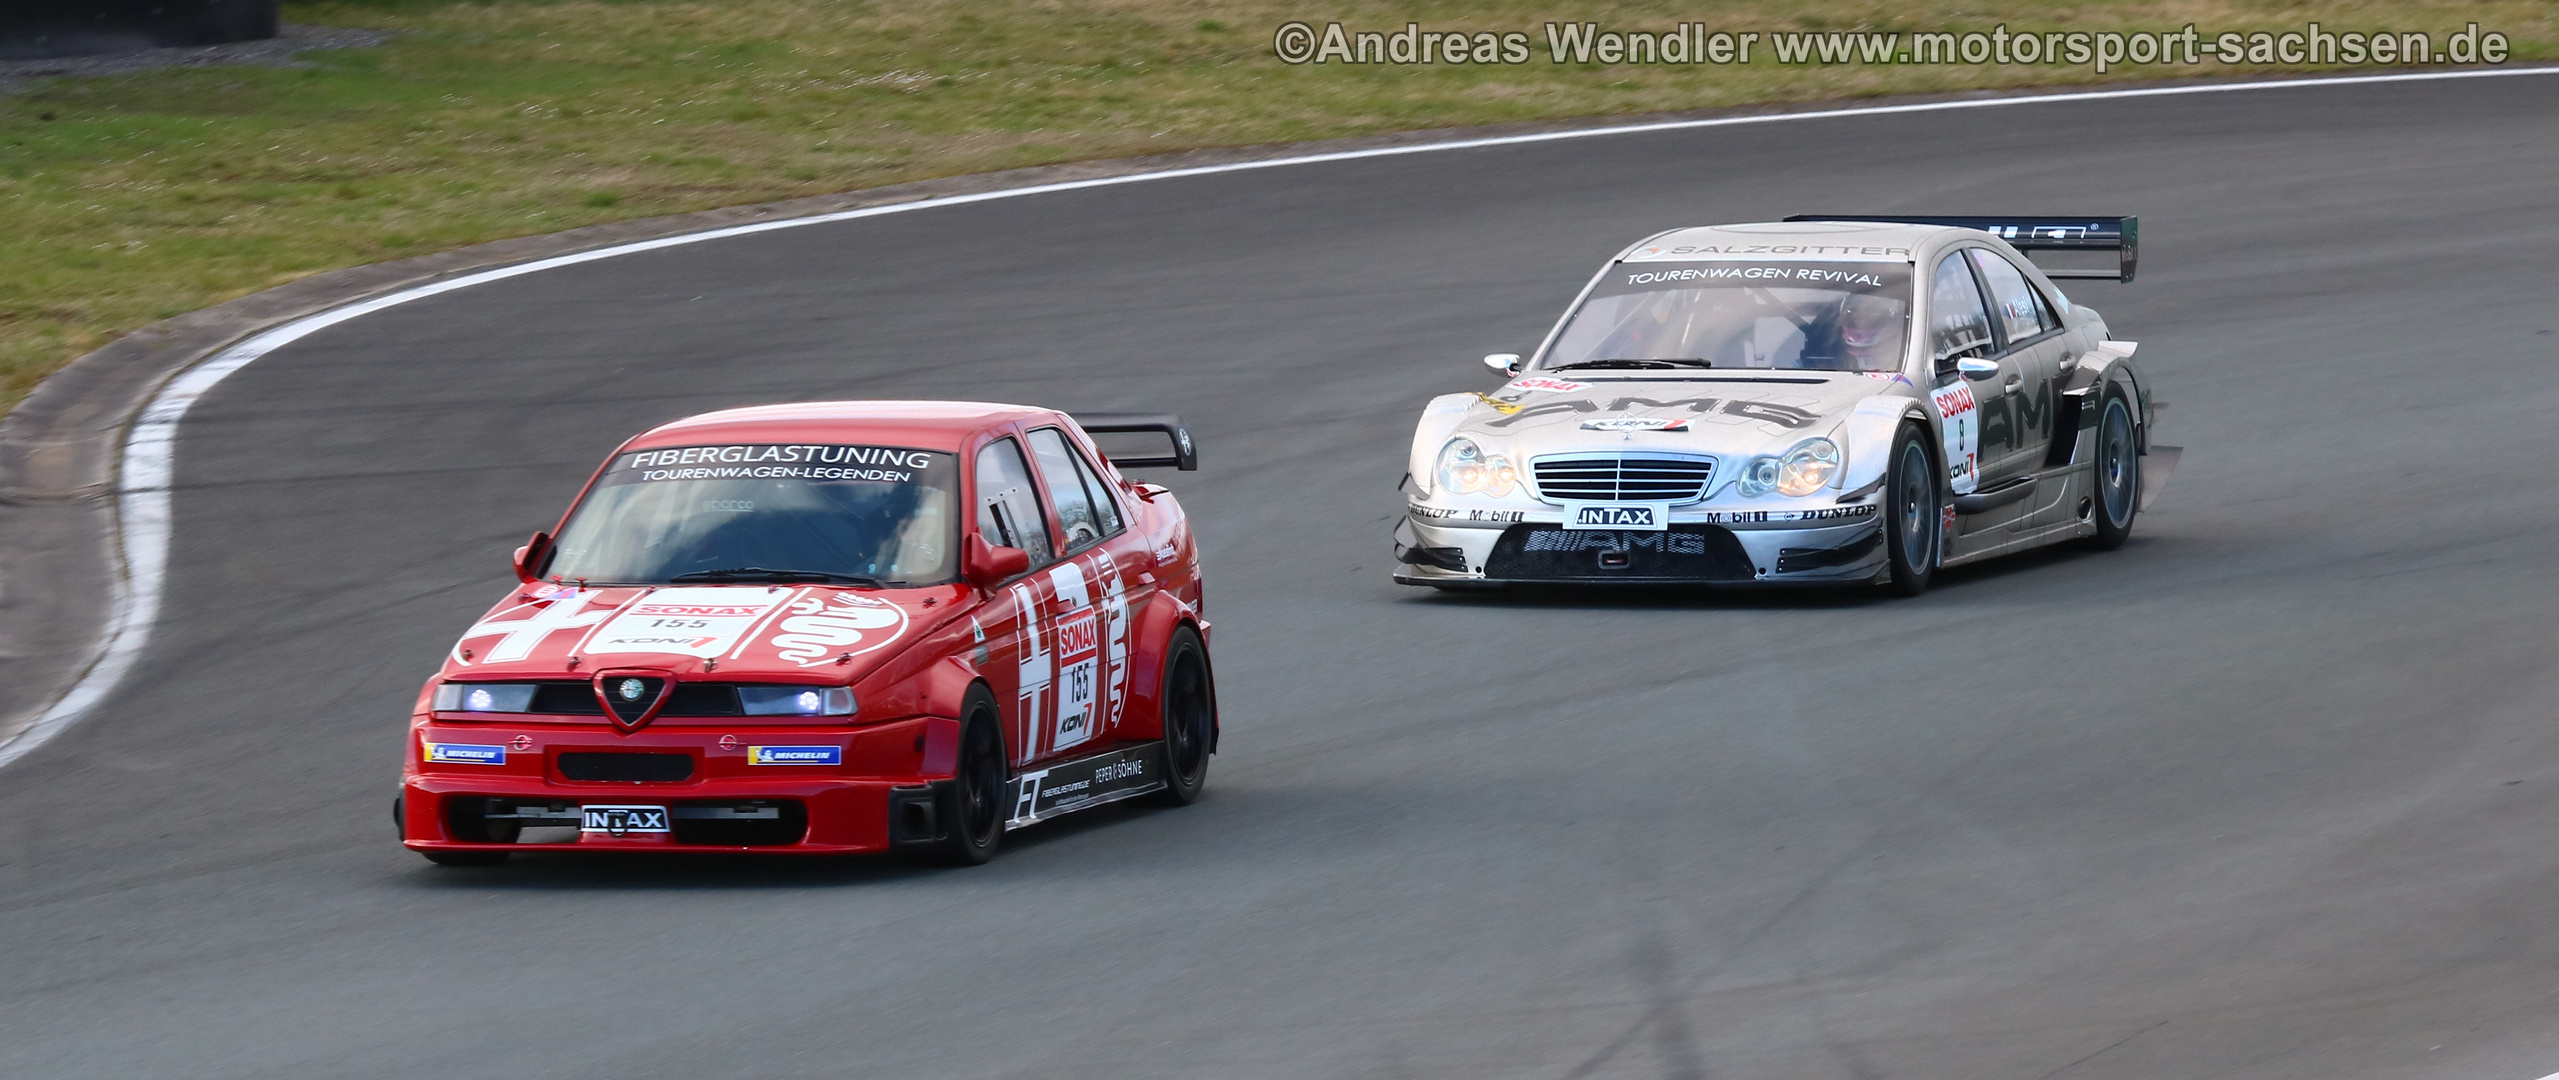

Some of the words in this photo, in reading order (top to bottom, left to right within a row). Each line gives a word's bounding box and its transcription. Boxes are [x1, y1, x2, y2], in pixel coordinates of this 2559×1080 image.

[1671, 245, 1909, 256] SALZGITTER
[1627, 267, 1791, 286] TOURENWAGEN
[1796, 268, 1882, 287] REVIVAL
[1487, 396, 1826, 429] AMG
[1936, 387, 1975, 419] SONAX
[1978, 375, 2064, 465] AM
[1958, 419, 1965, 451] 8
[631, 445, 931, 470] FIBERGLASTUNING
[642, 466, 911, 483] TOURENWAGEN-LEGENDEN
[703, 500, 754, 511] sparco
[1801, 504, 1877, 520] DUNLOP
[1469, 509, 1509, 522] Mobil
[1582, 508, 1651, 525] INTAX
[1706, 511, 1751, 524] Mobil
[635, 606, 761, 615] SONAX
[651, 619, 711, 628] 155
[1061, 617, 1096, 655] SONAX
[1071, 663, 1089, 704] 155
[1060, 708, 1088, 735] KONI
[446, 750, 496, 759] MICHELIN
[1014, 769, 1049, 824] FT
[584, 809, 663, 828] INTAX
